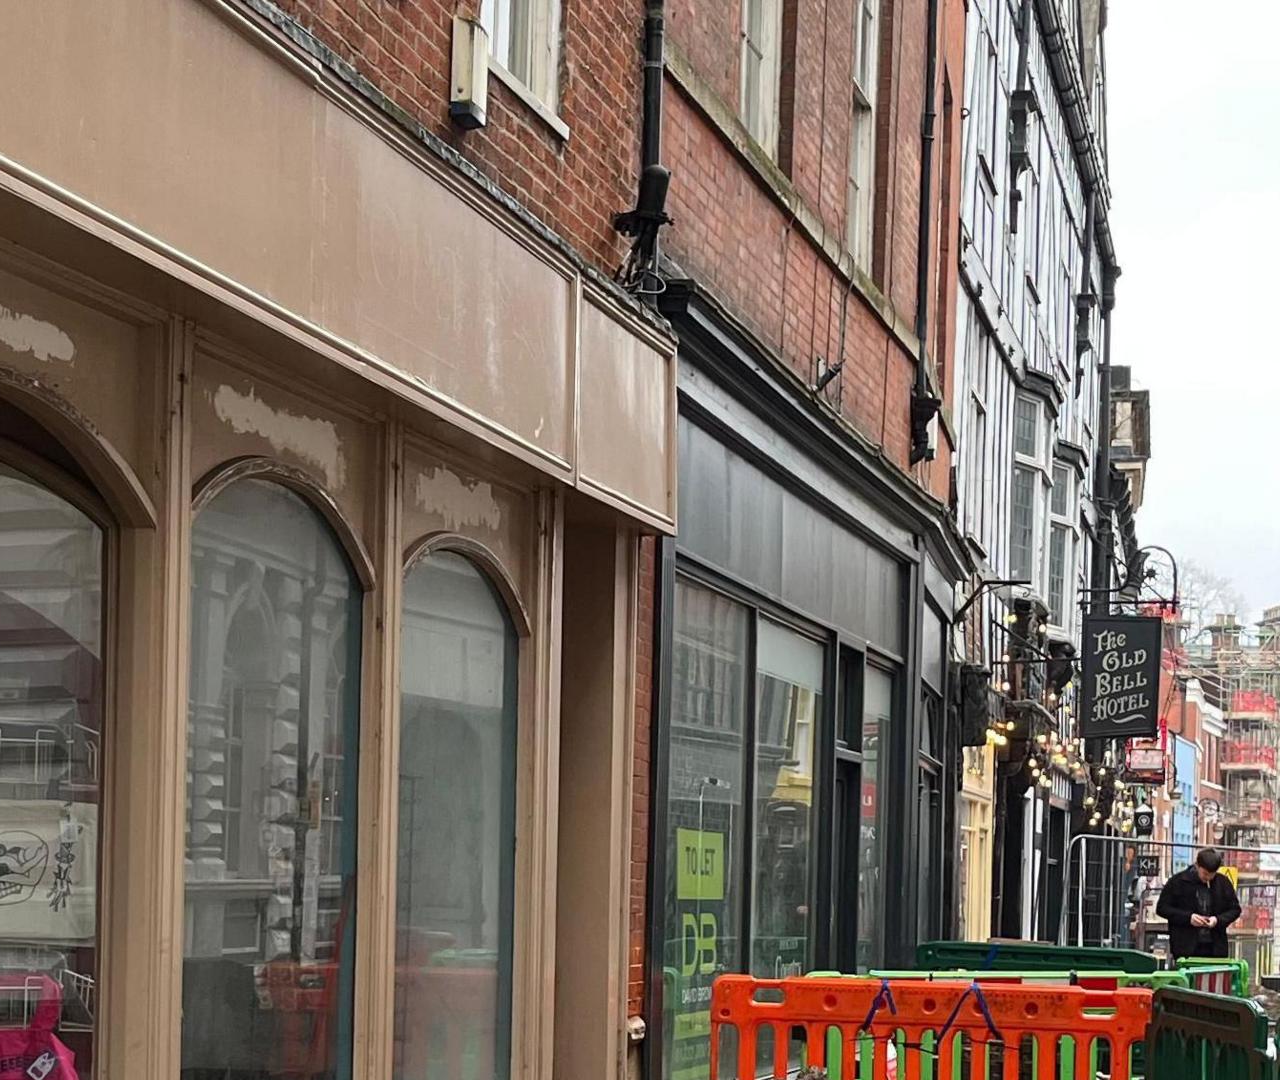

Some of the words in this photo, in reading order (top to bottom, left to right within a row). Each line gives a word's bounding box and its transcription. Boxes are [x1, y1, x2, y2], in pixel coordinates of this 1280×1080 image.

[1092, 630, 1126, 655] The
[1102, 649, 1147, 672] OLD
[1092, 671, 1147, 701] BELL
[1091, 693, 1149, 721] HOTEL
[685, 846, 697, 875] TO
[699, 848, 715, 876] LET
[1140, 858, 1156, 870] KH
[682, 912, 717, 977] DB
